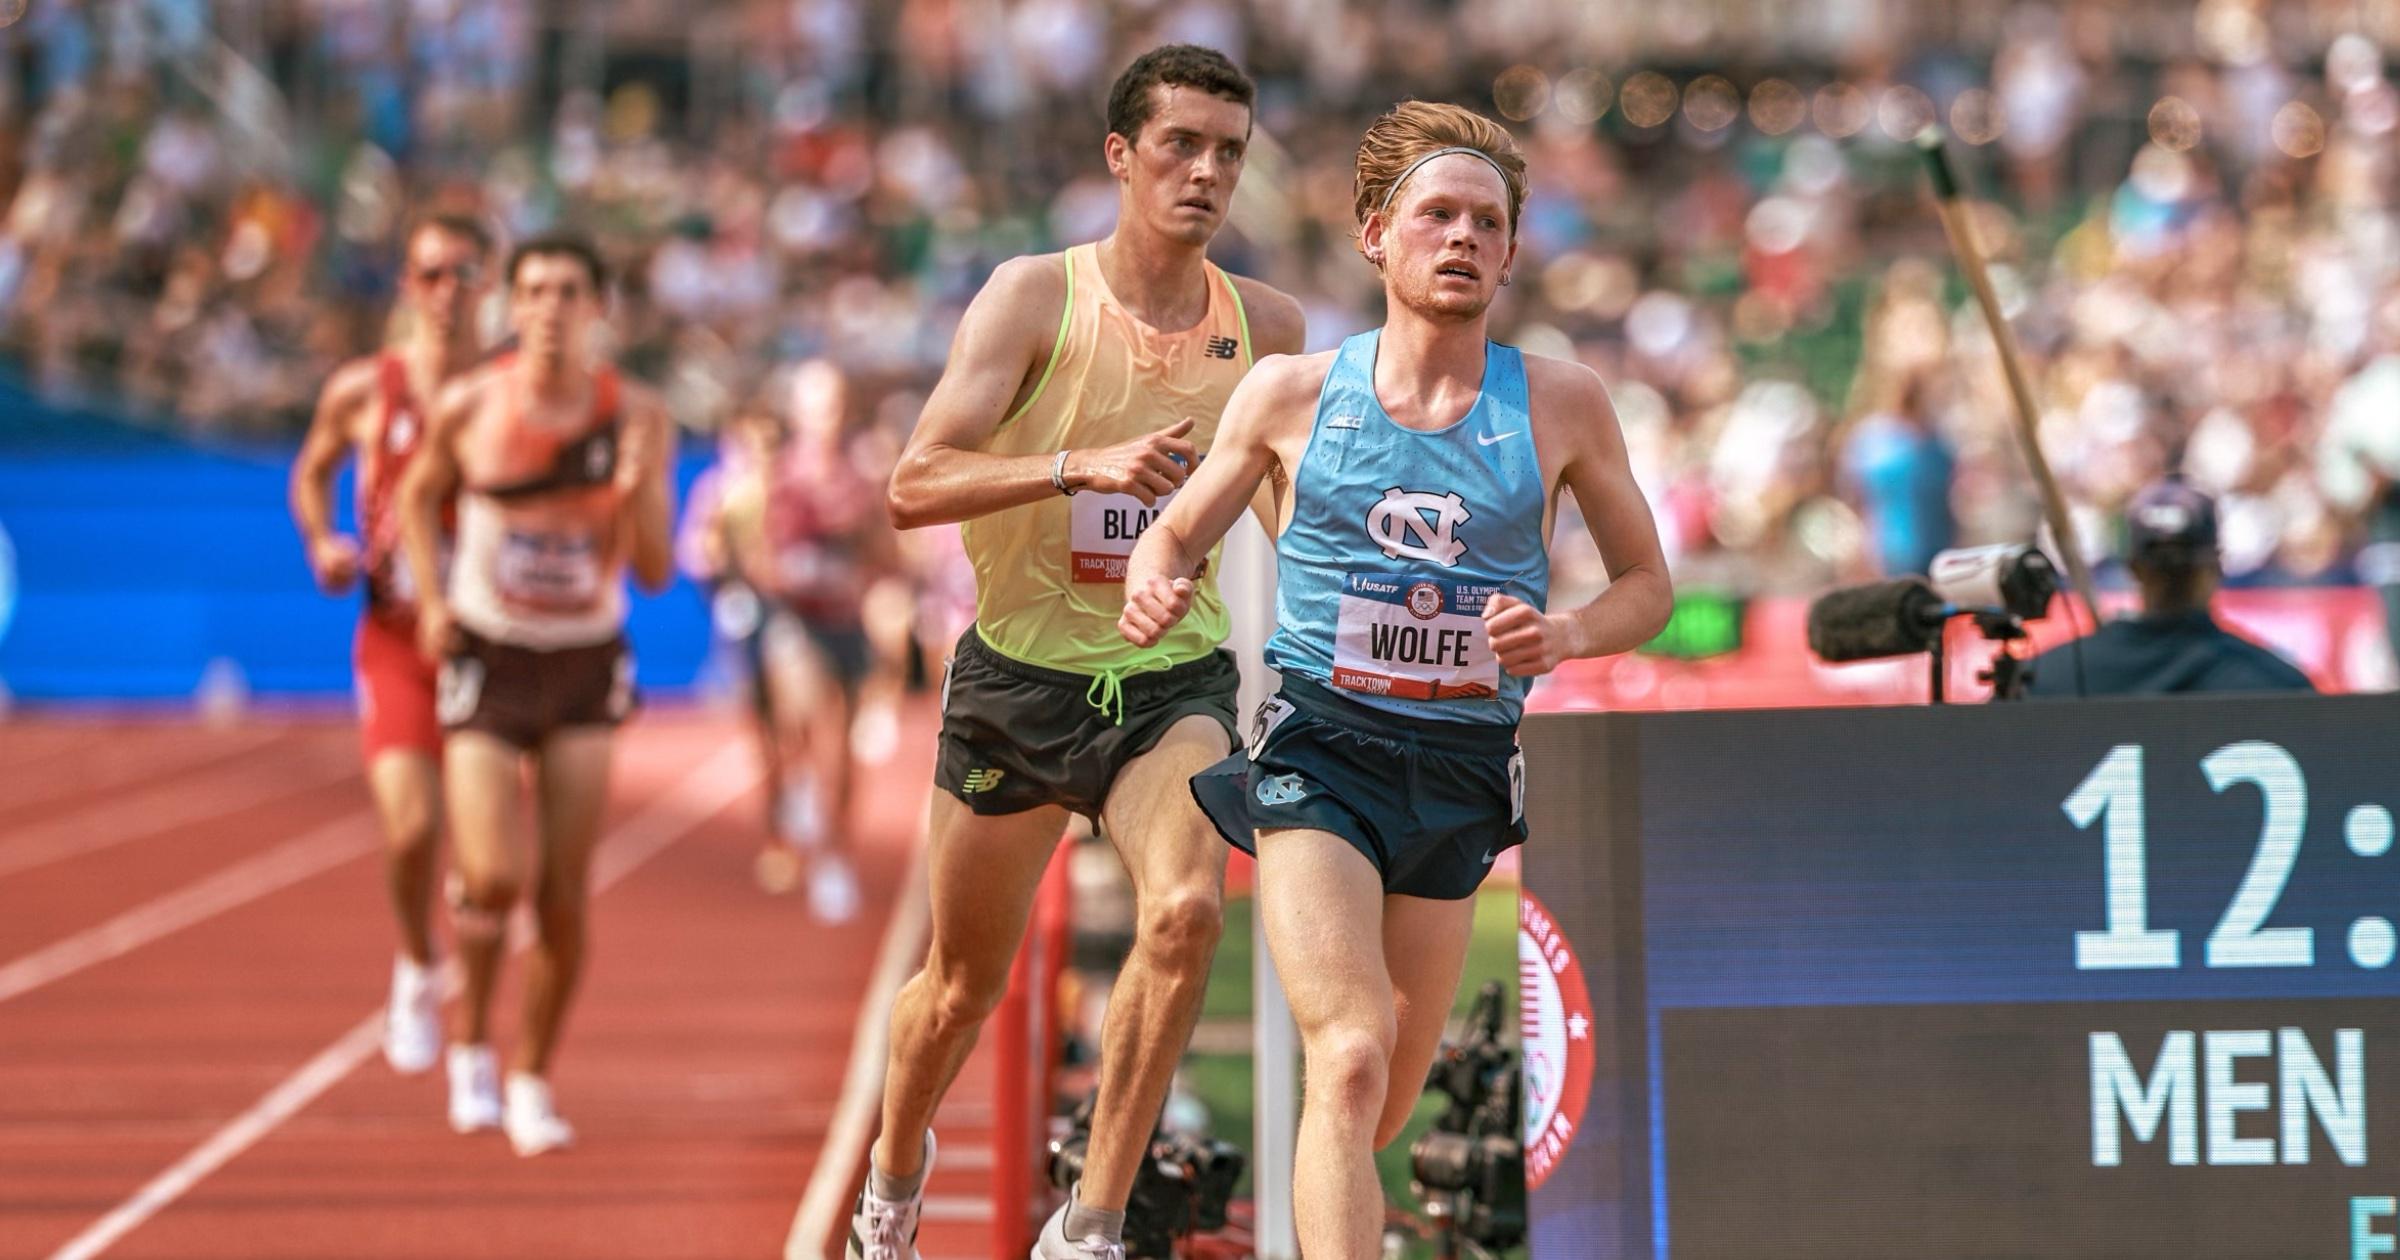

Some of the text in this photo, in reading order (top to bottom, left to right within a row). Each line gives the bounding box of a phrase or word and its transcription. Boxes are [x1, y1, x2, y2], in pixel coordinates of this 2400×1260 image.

[1326, 416, 1362, 429] ACC
[1104, 509, 1160, 540] BLA
[1105, 568, 1126, 578] 2024
[1367, 583, 1399, 594] USATF
[1456, 585, 1470, 594] U.S.
[1456, 595, 1488, 604] TEAM TRI
[1371, 623, 1472, 667] WOLFE
[1340, 674, 1392, 690] TRACKTOWN
[2060, 739, 2398, 970] 12:
[2088, 1027, 2368, 1167] MEN
